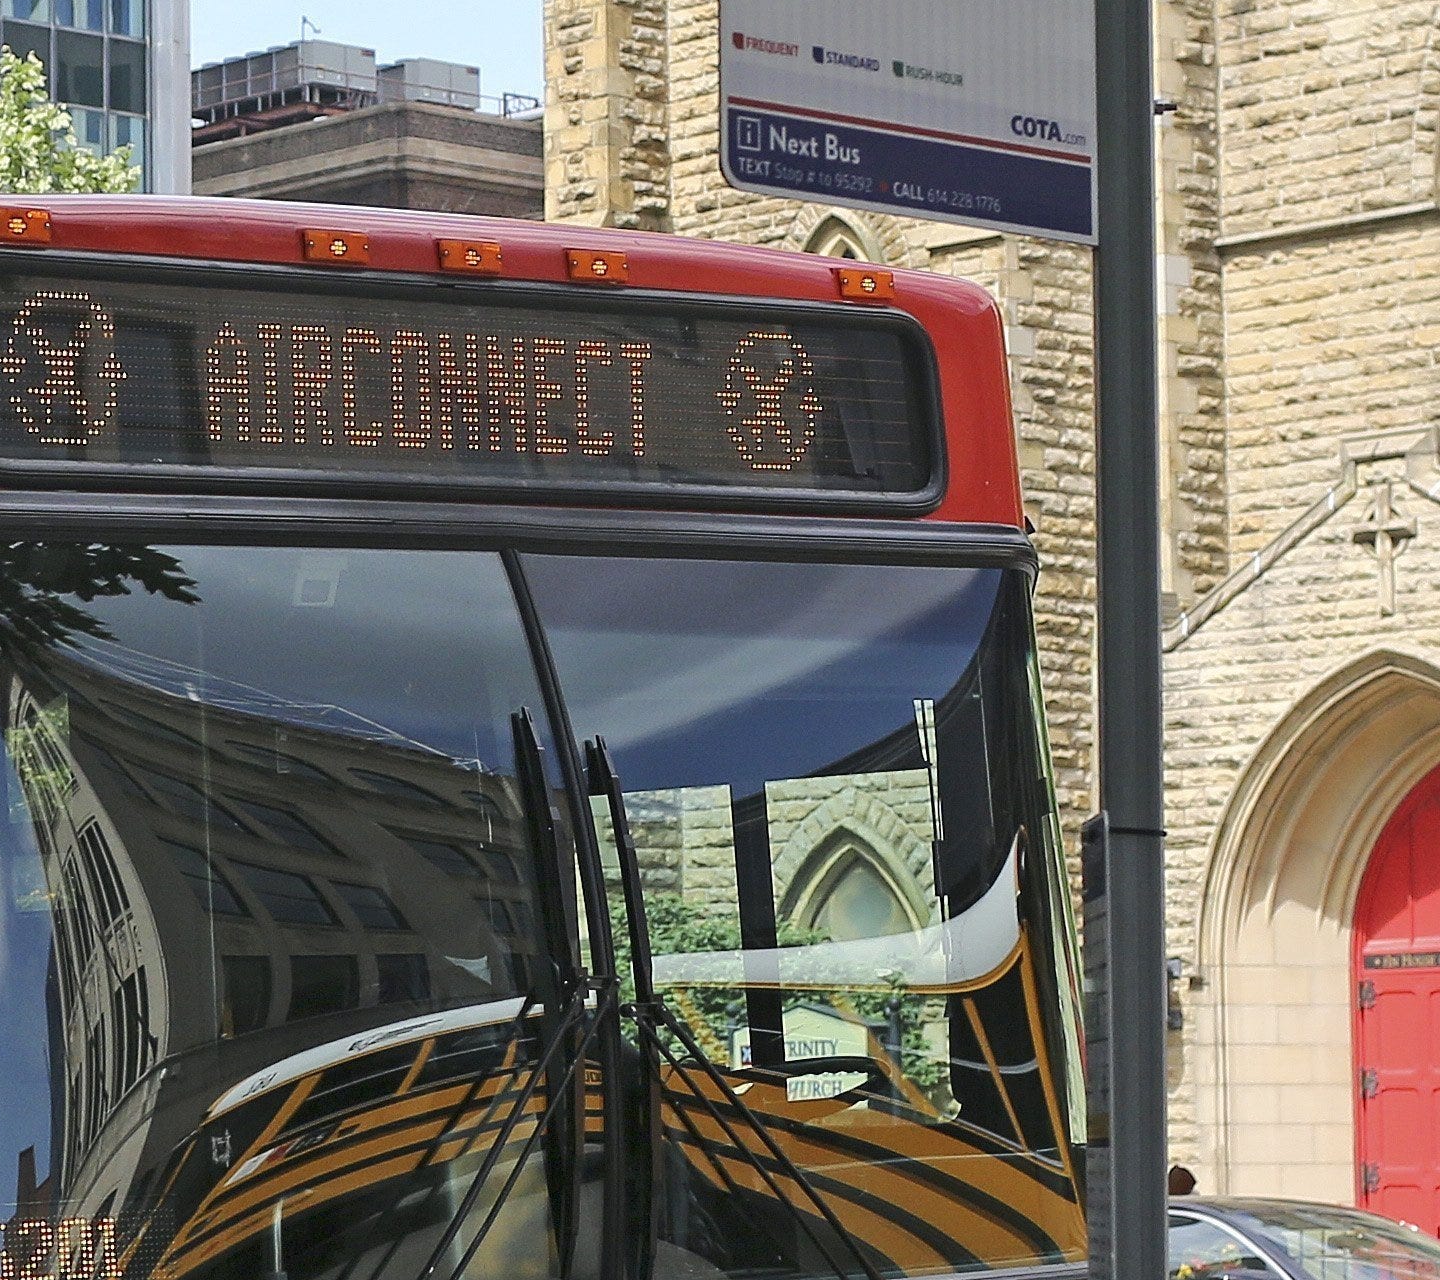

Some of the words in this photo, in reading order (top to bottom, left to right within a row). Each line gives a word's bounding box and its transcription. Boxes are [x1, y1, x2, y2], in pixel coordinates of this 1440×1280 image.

[746, 36, 799, 57] FREQUENT
[826, 51, 880, 71] STANDARD
[769, 123, 819, 158] Next
[825, 132, 860, 164] Bus
[1010, 115, 1087, 146] COTA.com
[738, 156, 771, 176] TEXT
[892, 181, 924, 202] CALL
[205, 319, 653, 458] AIRCONNECT
[787, 1079, 843, 1100] HURCH
